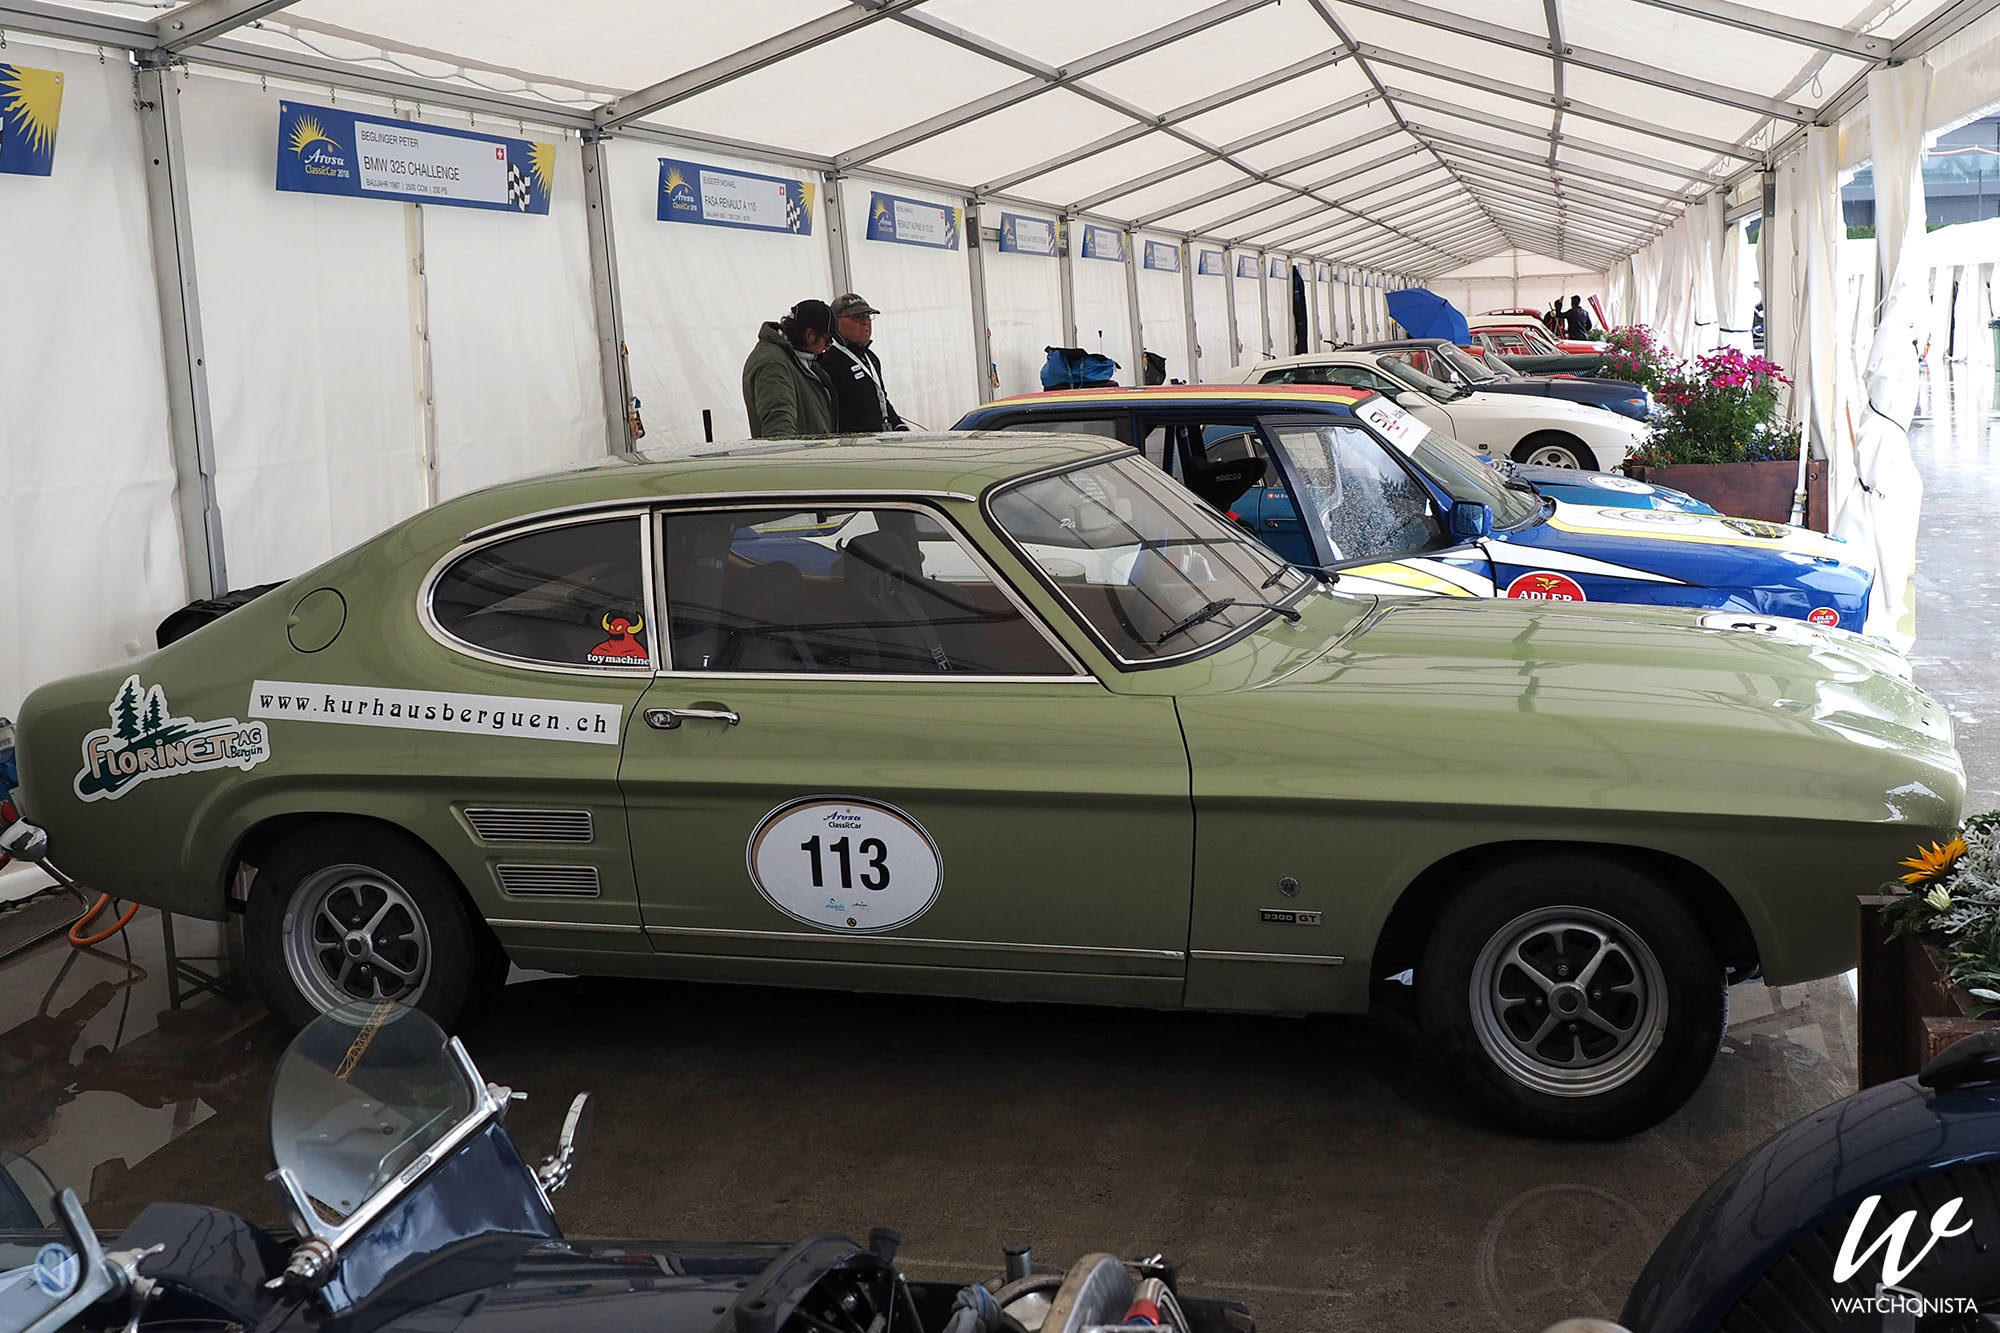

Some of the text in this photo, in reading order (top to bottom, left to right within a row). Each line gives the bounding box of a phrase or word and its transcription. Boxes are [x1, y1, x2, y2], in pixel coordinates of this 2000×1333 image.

[361, 130, 419, 148] BEGLINGER PETER
[304, 148, 345, 166] Arosa
[305, 164, 337, 177] ClassicCar
[363, 156, 460, 181] BMW 325 CHALLENGE
[704, 195, 718, 207] FASA
[719, 197, 742, 210] RENAULT
[259, 694, 607, 733] www.kurhausberguen.ch
[238, 728, 261, 746] AG
[230, 744, 263, 762] Bergün
[823, 811, 861, 820] Arosa
[828, 821, 862, 829] ClassicCar
[801, 835, 890, 891] 113
[1264, 913, 1317, 922] 2300 GT
